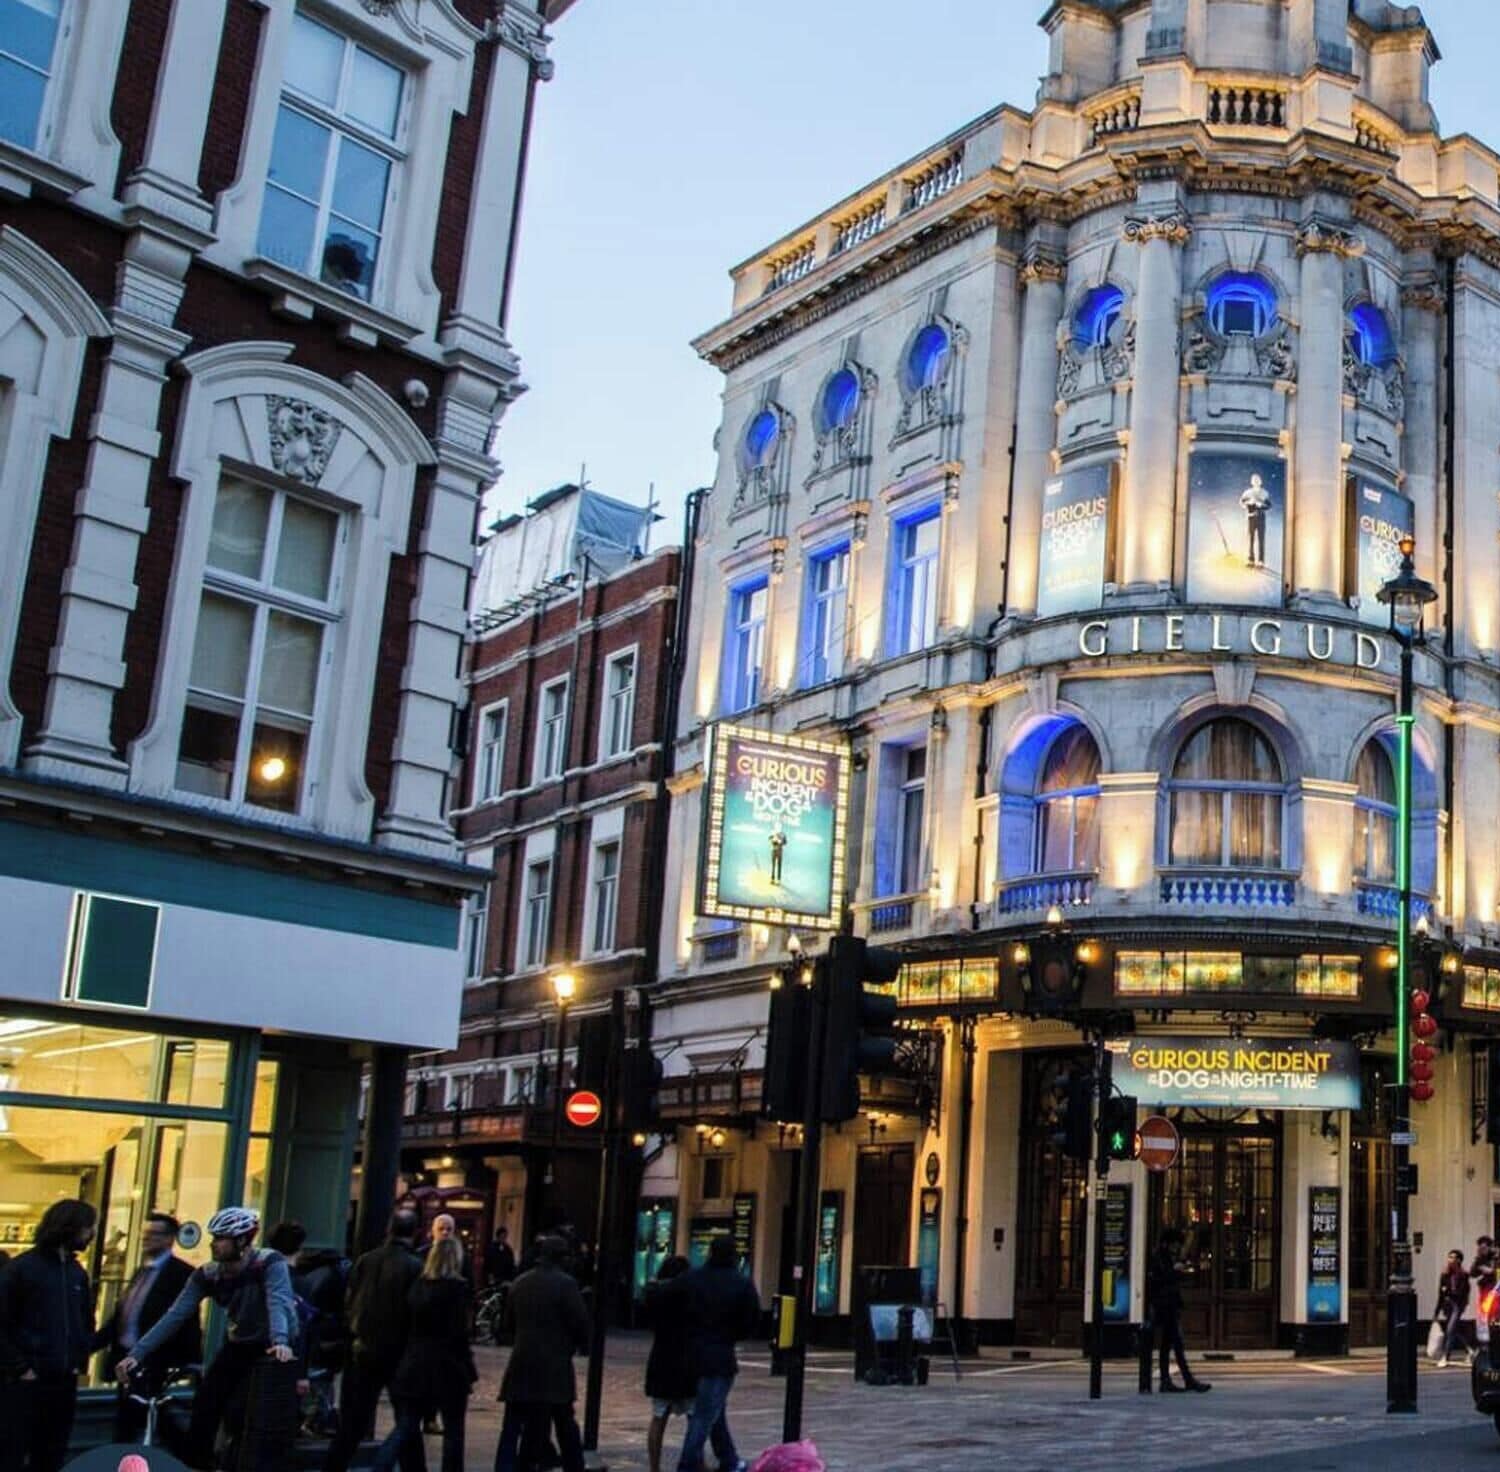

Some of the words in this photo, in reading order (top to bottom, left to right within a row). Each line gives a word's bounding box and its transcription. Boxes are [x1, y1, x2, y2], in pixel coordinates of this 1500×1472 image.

[1042, 497, 1106, 529] CURIOUS
[1079, 615, 1381, 670] GIELGUD
[736, 754, 827, 787] CURIOUS
[751, 778, 818, 801] INCIDENT
[754, 793, 801, 816] DOG
[1132, 1050, 1229, 1070] CURIOUS
[1233, 1051, 1331, 1072] INCIDENT
[1158, 1070, 1211, 1089] DOG
[1221, 1071, 1317, 1089] NIGHT-TIME
